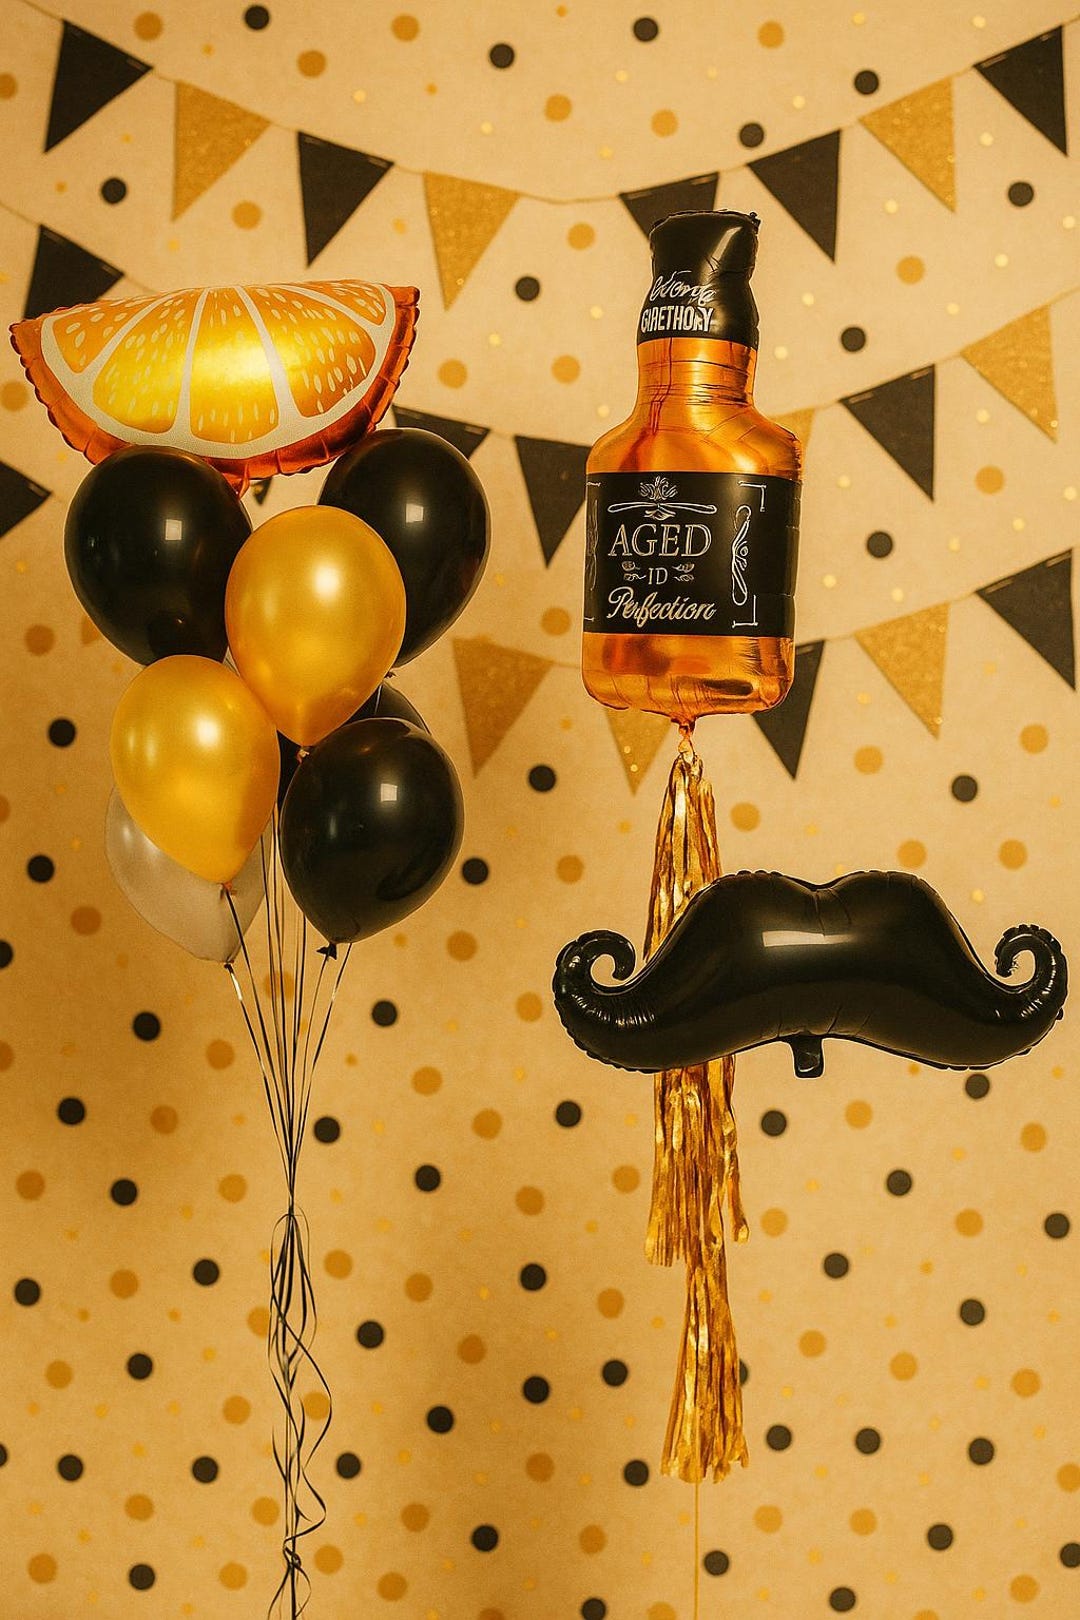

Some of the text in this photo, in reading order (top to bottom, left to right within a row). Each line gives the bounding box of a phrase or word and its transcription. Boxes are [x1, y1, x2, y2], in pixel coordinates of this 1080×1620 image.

[608, 523, 712, 557] AGED
[648, 567, 669, 585] ID
[606, 586, 717, 628] Perfection
